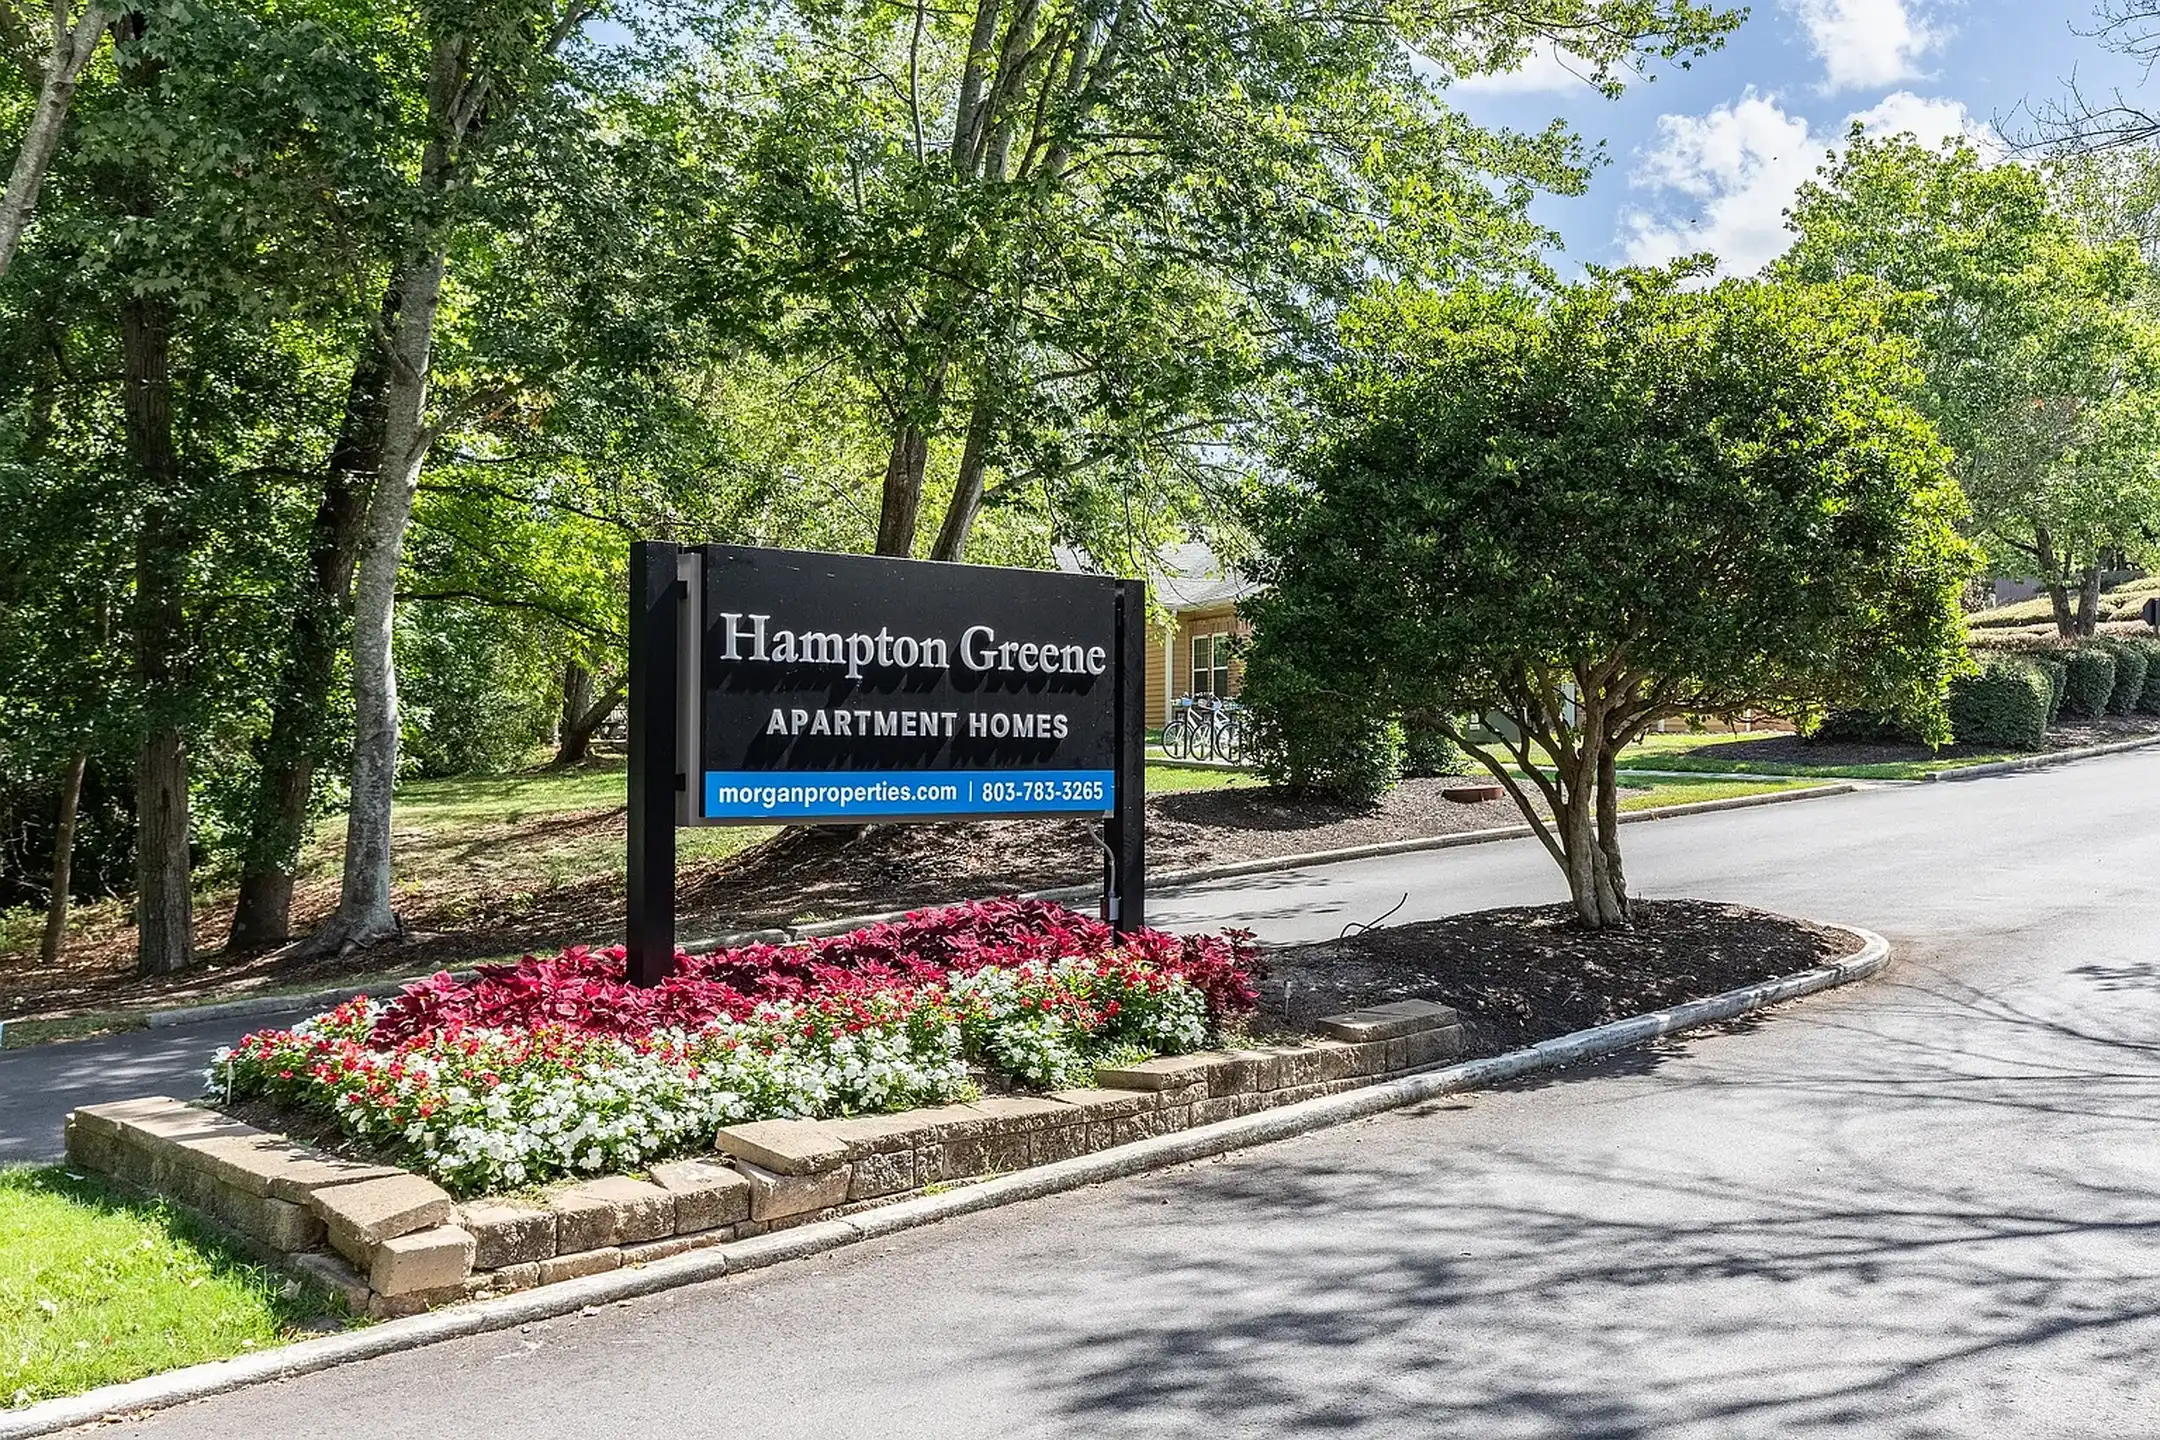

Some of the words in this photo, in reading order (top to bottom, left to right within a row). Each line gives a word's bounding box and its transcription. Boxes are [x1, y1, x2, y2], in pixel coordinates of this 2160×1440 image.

[719, 612, 950, 680] Hampton
[960, 625, 1107, 676] Greene
[766, 708, 958, 737] APARTMENT
[969, 712, 1069, 739] HOMES
[719, 780, 957, 809] morganproperties.com
[982, 780, 1103, 802] 803-783-3265
